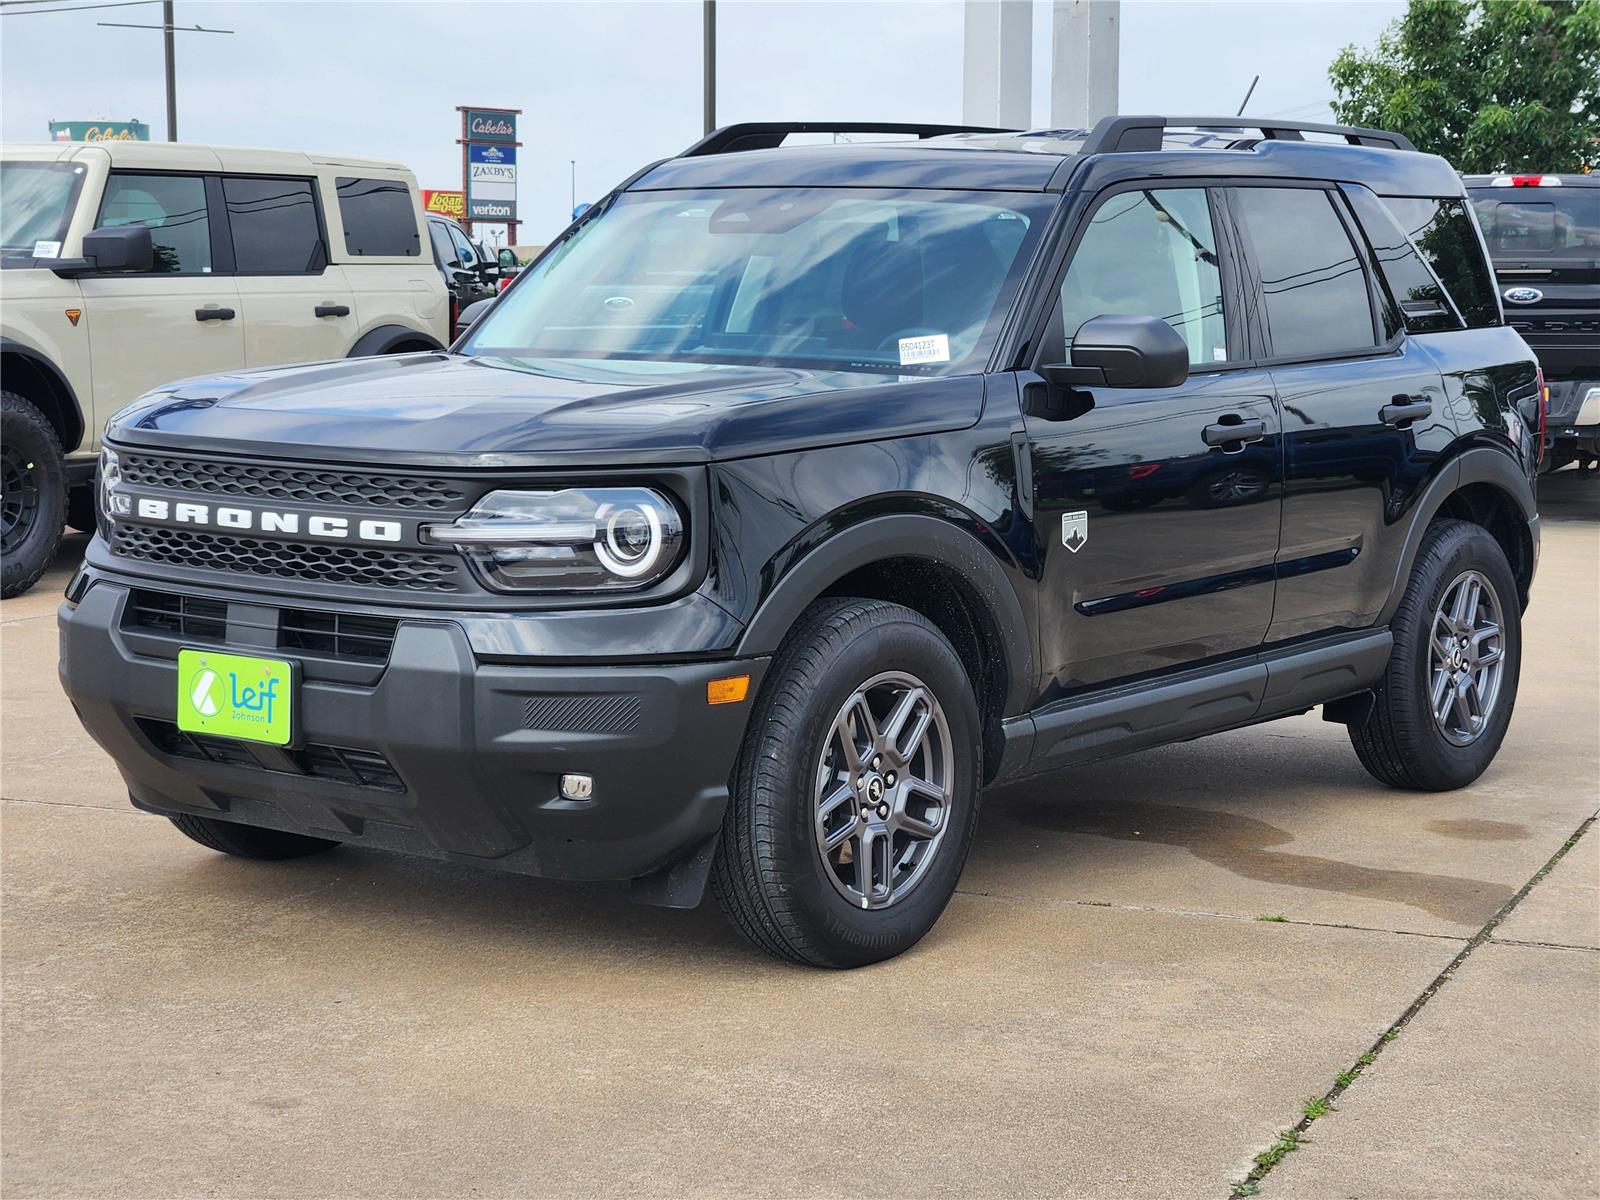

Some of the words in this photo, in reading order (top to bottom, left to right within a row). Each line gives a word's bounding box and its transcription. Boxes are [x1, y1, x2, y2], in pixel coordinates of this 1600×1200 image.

[472, 118, 513, 134] Cabela's
[473, 166, 514, 179] ZAXBY'S
[473, 204, 510, 216] verizon
[138, 499, 401, 541] BRONCO
[228, 672, 280, 724] leif
[231, 710, 265, 723] Johnson
